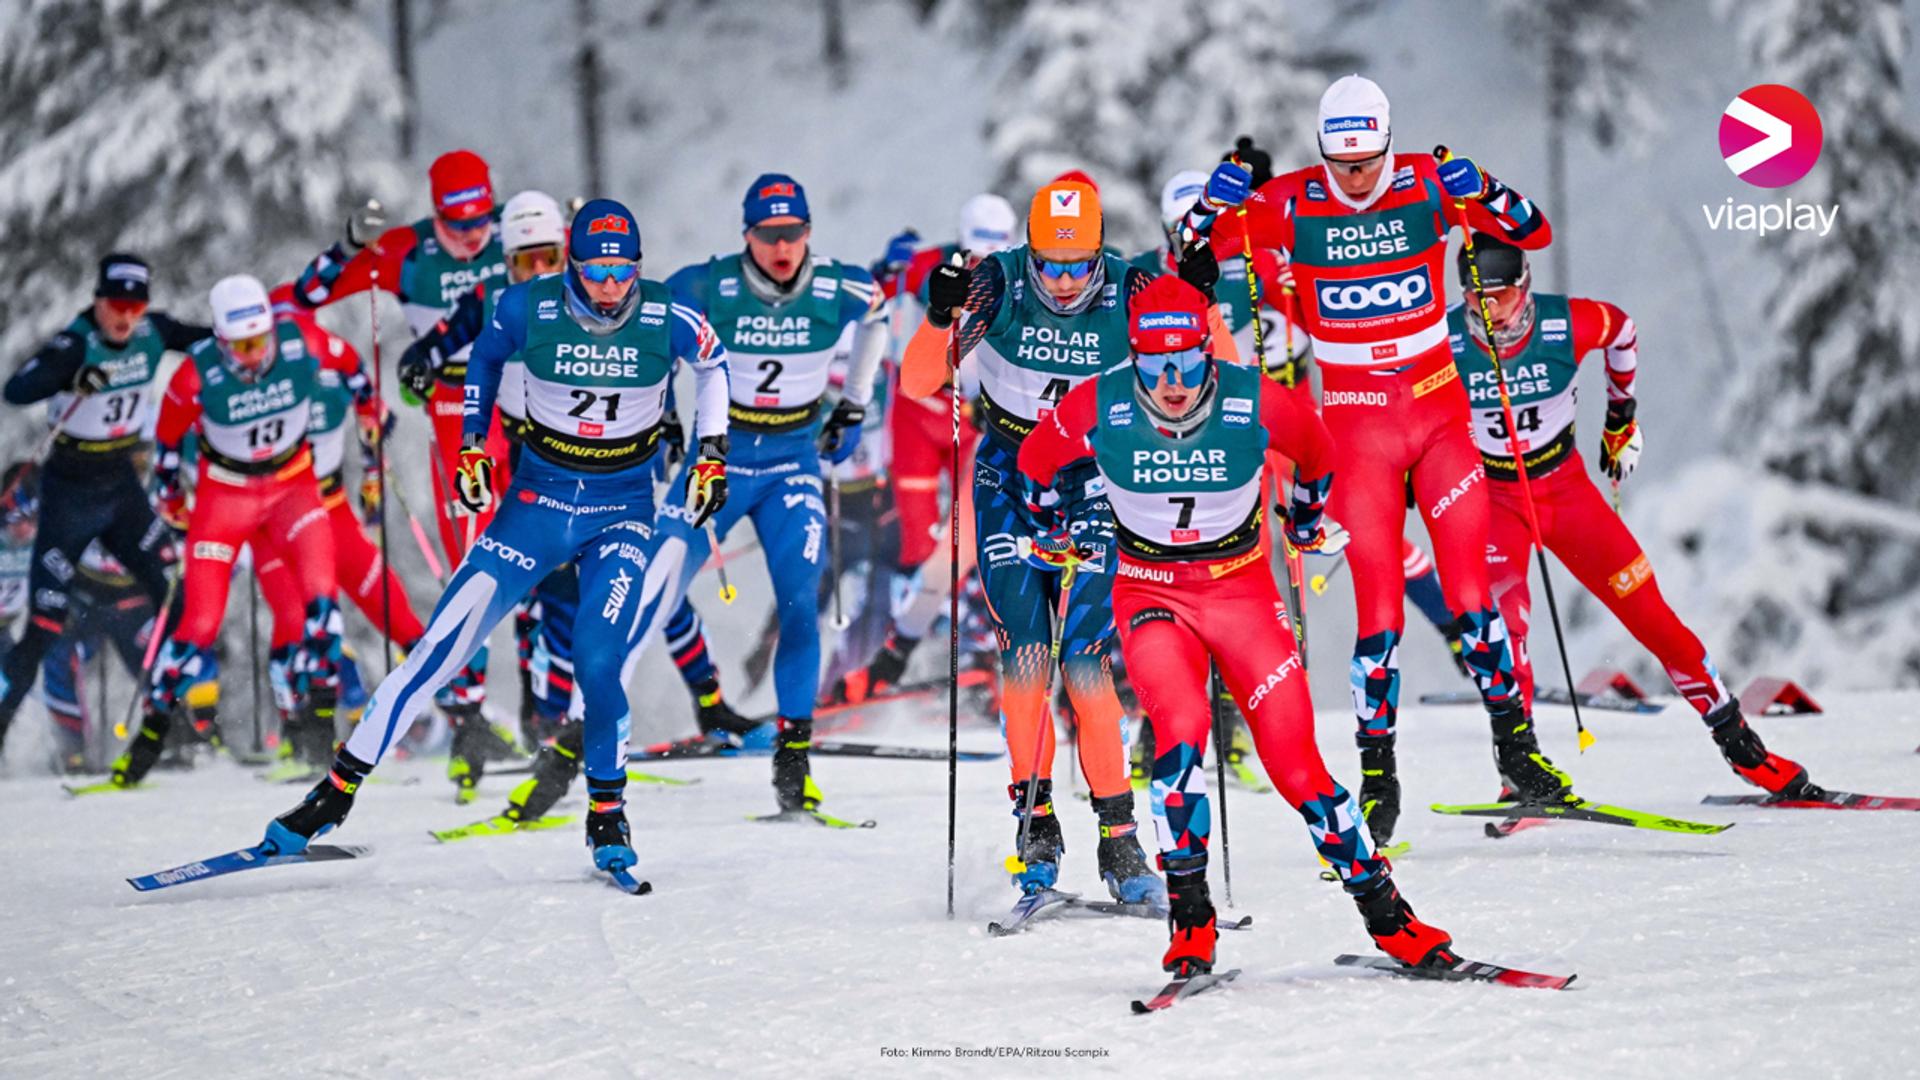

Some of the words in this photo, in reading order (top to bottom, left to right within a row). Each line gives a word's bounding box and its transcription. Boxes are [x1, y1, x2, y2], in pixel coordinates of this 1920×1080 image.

[1326, 219, 1405, 243] POLAR
[1327, 237, 1410, 261] HOUSE
[1321, 274, 1427, 310] coop
[736, 316, 810, 330] POLAR
[1138, 315, 1190, 328] SpareBank
[1191, 317, 1198, 327] 1
[1358, 317, 1396, 328] COUNTRY
[1396, 310, 1424, 323] WORLD
[734, 331, 811, 347] HOUSE
[1021, 327, 1099, 348] POLAR
[555, 343, 639, 362] POLAR
[1017, 345, 1101, 365] HOUSE
[554, 360, 639, 378] HOUSE
[755, 360, 783, 394] 2
[1468, 363, 1548, 387] POLAR
[227, 379, 293, 405] POLAR
[1038, 378, 1071, 407] 4
[1469, 379, 1552, 402] HOUSE
[104, 392, 140, 424] 37
[228, 394, 295, 422] HOUSE
[568, 389, 621, 421] 21
[1223, 414, 1250, 424] coop
[1484, 405, 1543, 440] 34
[244, 419, 284, 447] 13
[542, 436, 638, 458] FINNFORM
[1133, 449, 1226, 465] POLAR
[1133, 467, 1228, 483] HOUSE
[1431, 470, 1479, 519] CRAFT
[1168, 496, 1195, 529] 7
[1248, 657, 1299, 711] CRAFT
